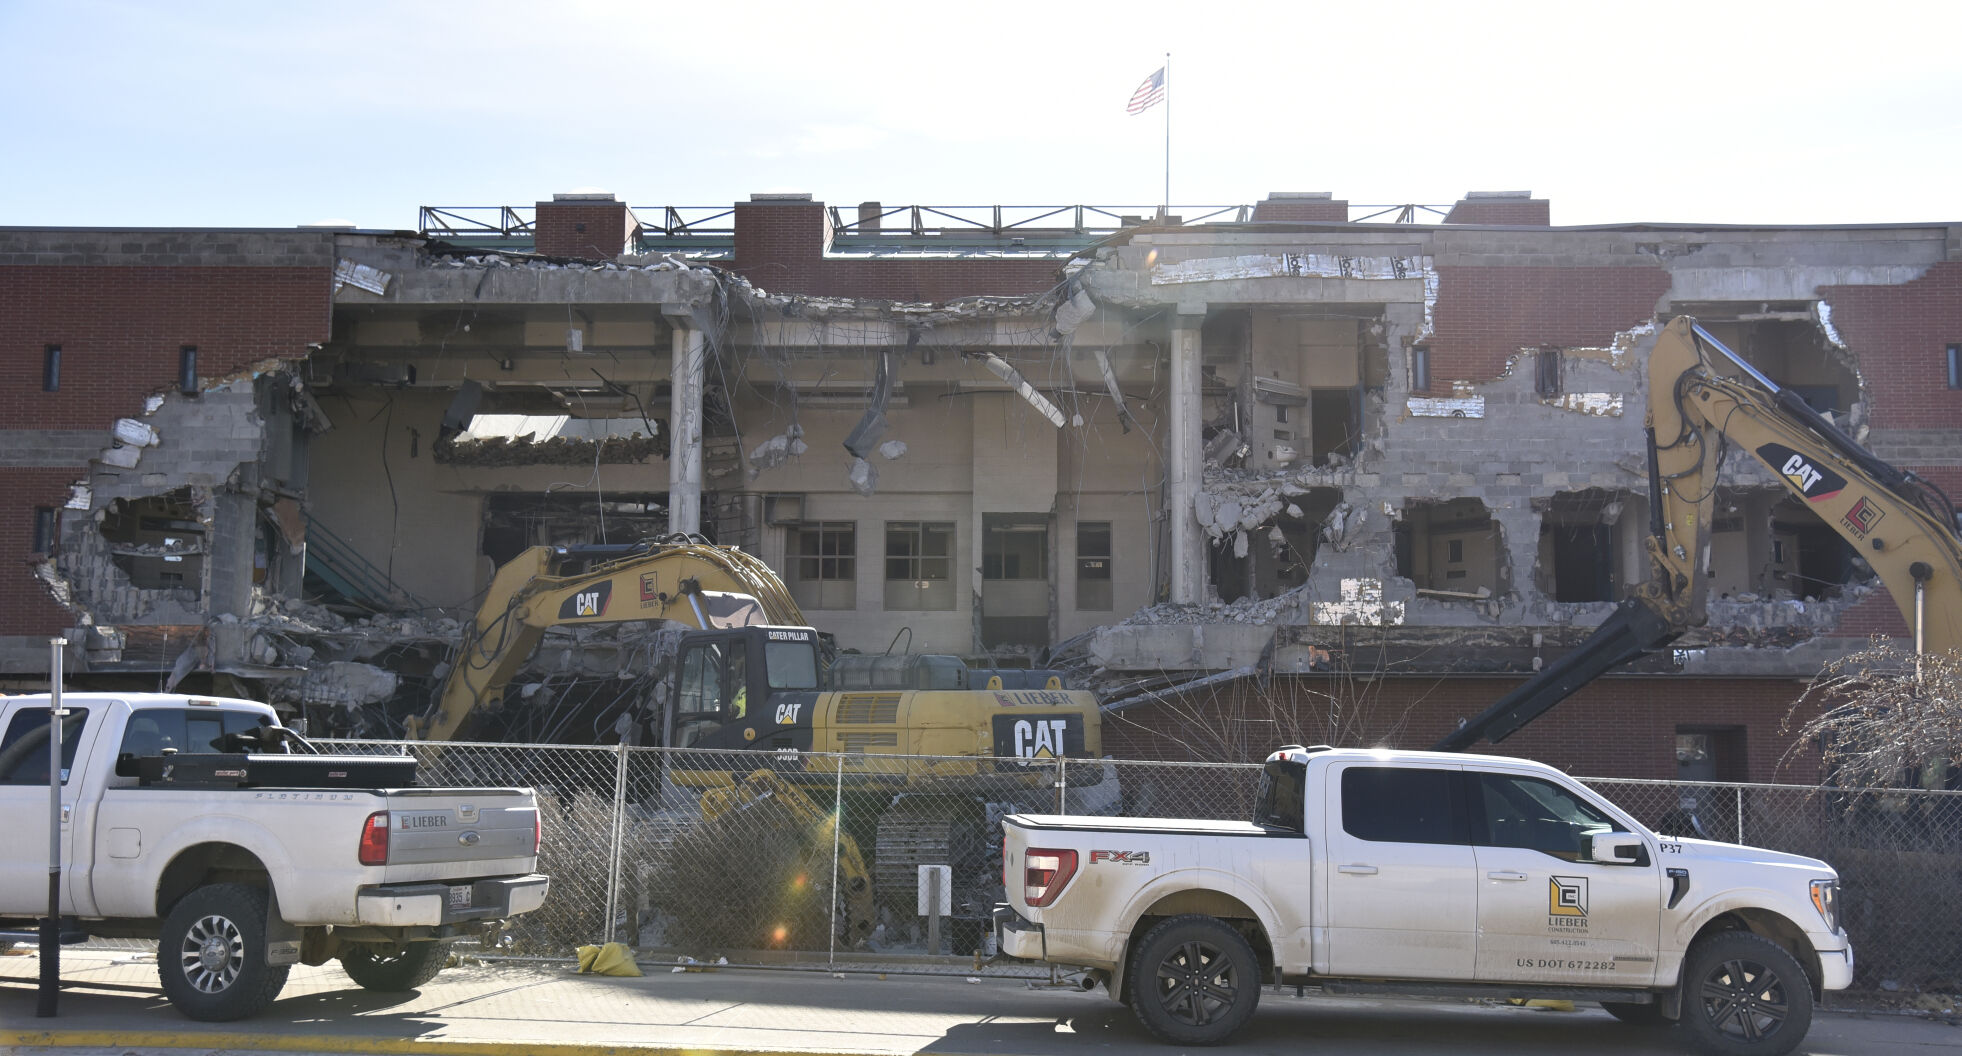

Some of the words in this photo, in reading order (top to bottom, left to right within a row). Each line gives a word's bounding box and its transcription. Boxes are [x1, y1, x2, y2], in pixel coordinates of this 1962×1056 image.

[1781, 454, 1823, 493] CAT
[1840, 517, 1865, 541] LIEBER
[576, 592, 599, 616] CAT
[640, 600, 659, 609] LIEBER
[768, 631, 809, 640] CATERPILLAR
[1014, 692, 1074, 705] LIEBER
[775, 703, 801, 724] CAT
[1014, 719, 1067, 766] CAT
[412, 816, 447, 828] LIEBER
[1660, 843, 1682, 854] P37
[1089, 850, 1150, 864] FX4
[1548, 917, 1588, 927] LIEBER
[1547, 926, 1589, 934] CONSTRUCTION
[1516, 958, 1534, 968] US
[1538, 959, 1565, 969] DOT
[1568, 960, 1616, 970] 672282
